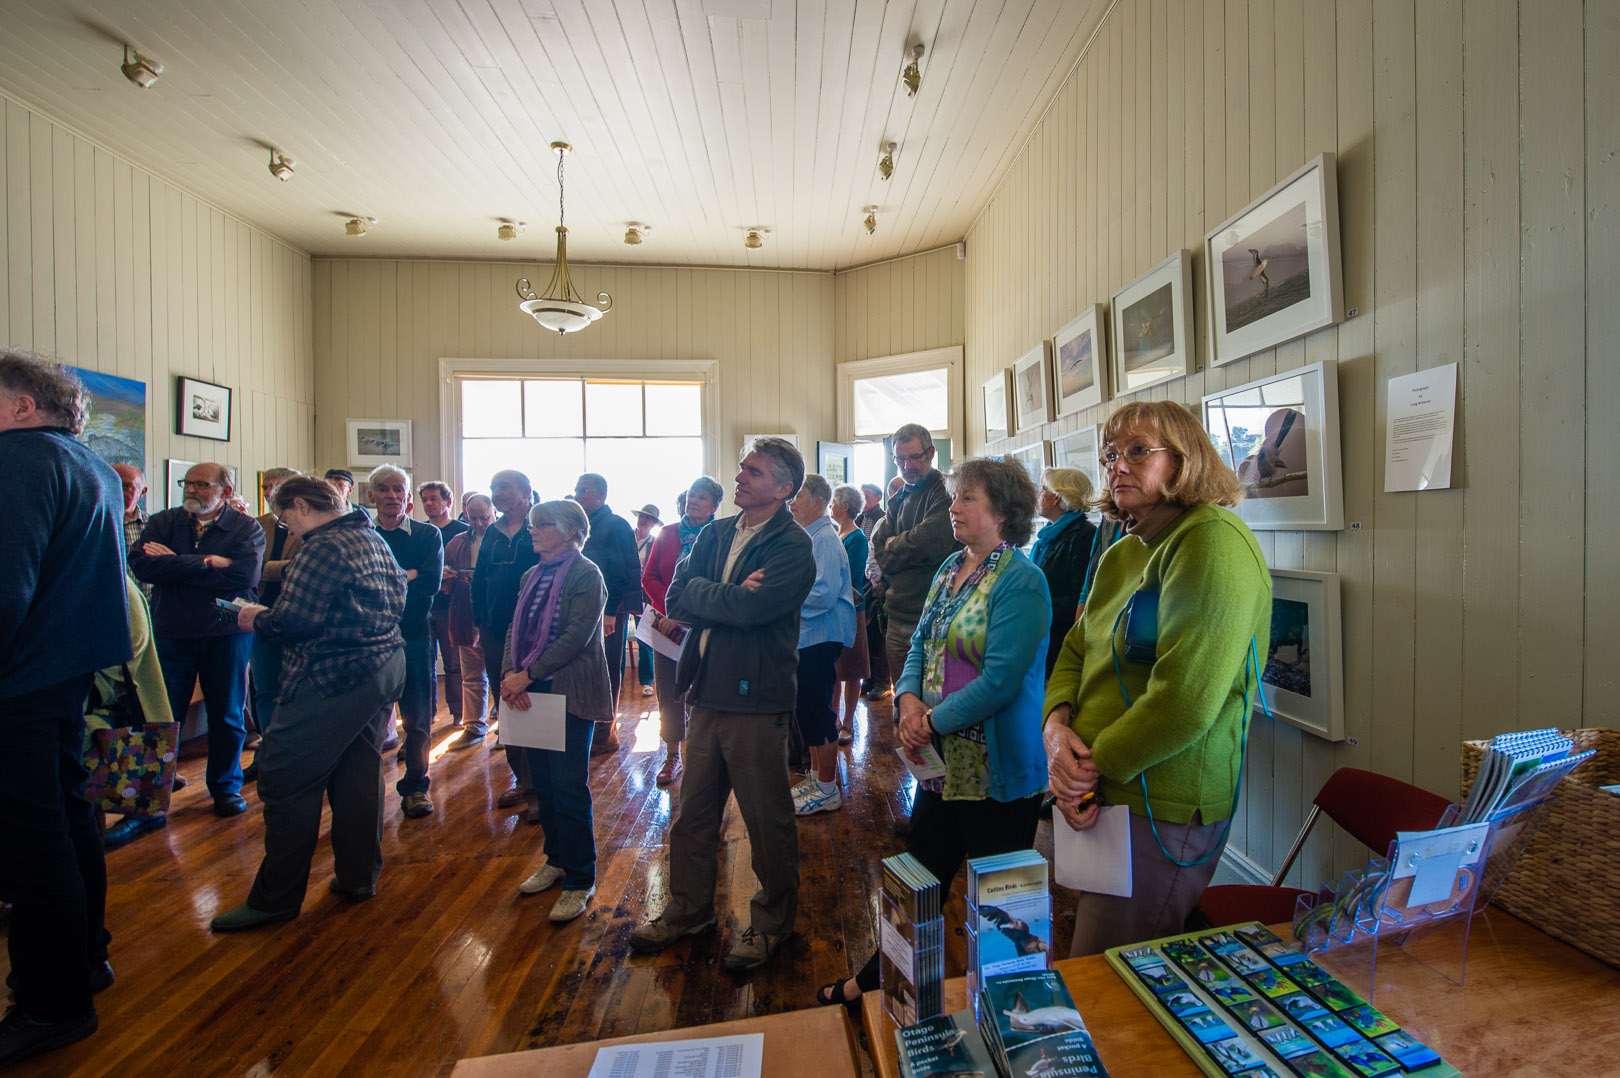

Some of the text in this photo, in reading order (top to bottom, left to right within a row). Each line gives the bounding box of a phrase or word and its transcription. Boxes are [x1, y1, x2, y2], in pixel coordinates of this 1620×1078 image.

[1348, 308, 1357, 316] 47
[1004, 883, 1018, 891] Birds
[902, 1025, 935, 1038] Otago
[904, 1029, 956, 1048] Peninsula
[906, 1044, 935, 1057] Birds
[916, 1055, 939, 1067] pocket
[1062, 1053, 1093, 1065] Birds
[911, 1065, 931, 1075] guide
[1039, 1065, 1099, 1078] Peninsula
